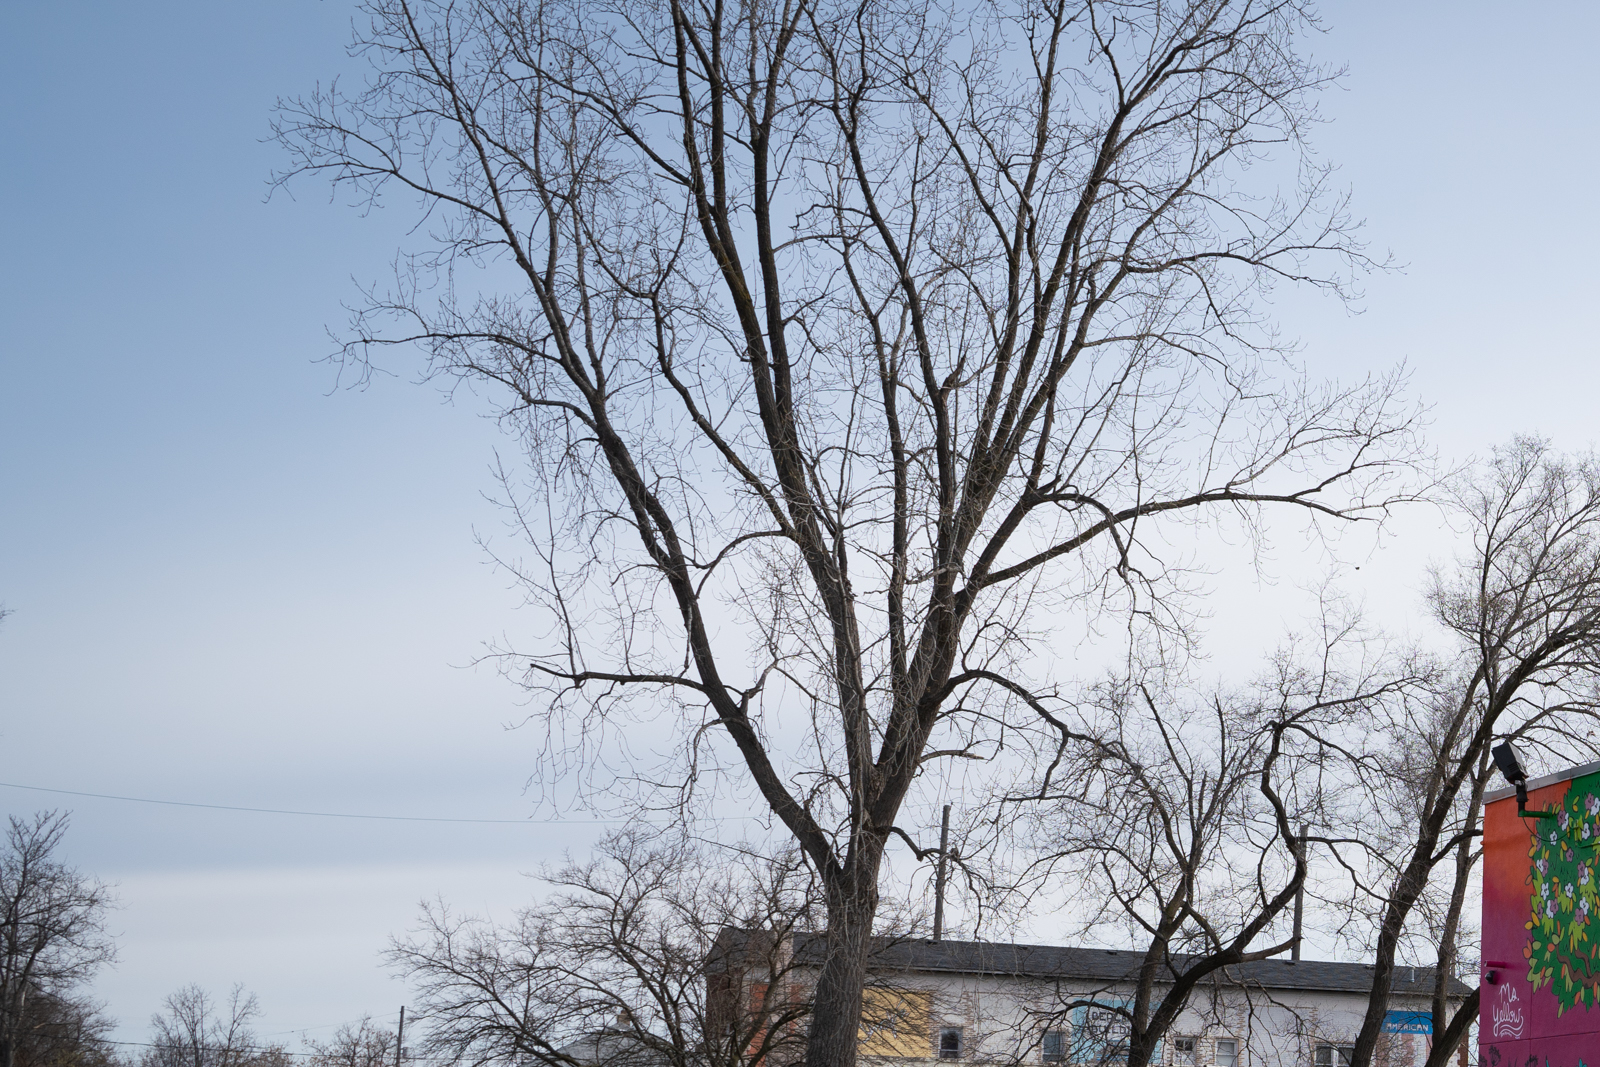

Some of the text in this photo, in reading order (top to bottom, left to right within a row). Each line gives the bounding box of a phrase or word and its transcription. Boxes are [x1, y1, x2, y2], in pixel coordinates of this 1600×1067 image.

[1499, 982, 1520, 1003] Ms.
[1386, 1023, 1429, 1031] AMERICAN
[1493, 1001, 1521, 1037] Yellow
